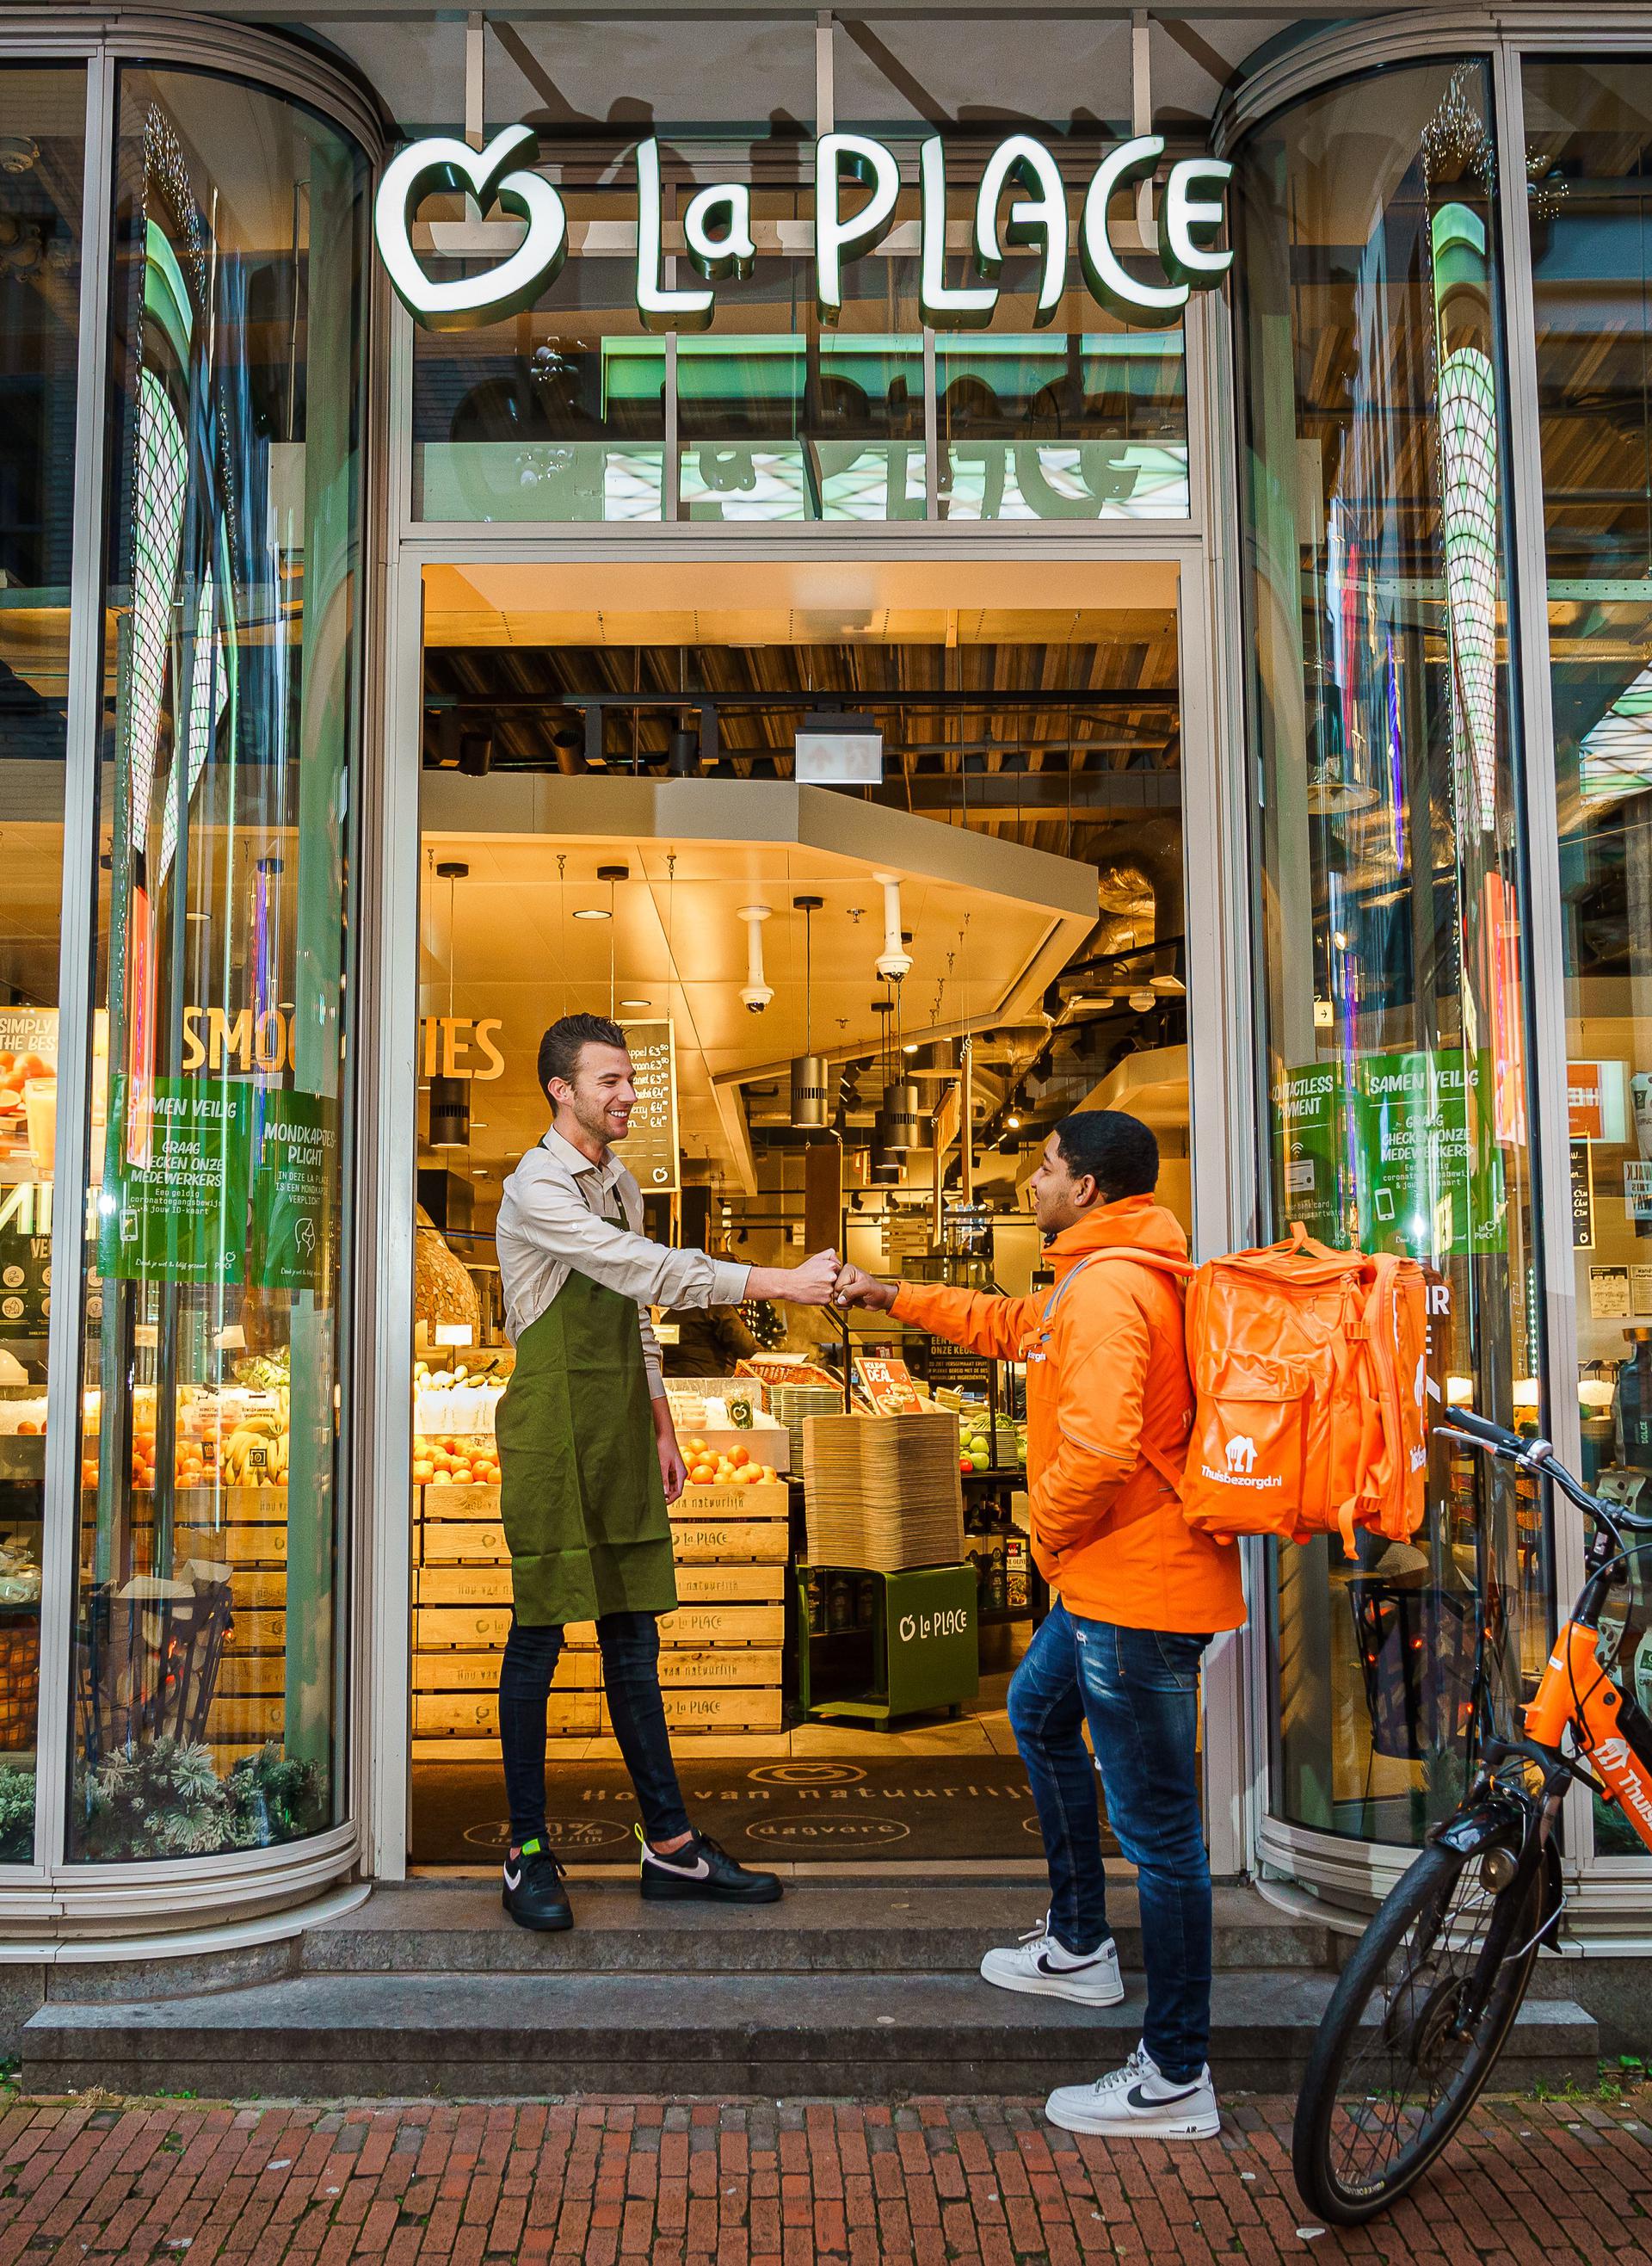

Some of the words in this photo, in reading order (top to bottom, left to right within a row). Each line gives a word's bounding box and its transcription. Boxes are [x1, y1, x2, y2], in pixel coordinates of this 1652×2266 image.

[636, 133, 757, 325] La
[814, 132, 1235, 325] PLACE
[0, 1017, 52, 1034] SIMPLY
[0, 1034, 26, 1051] THE
[28, 1034, 57, 1051] BES
[1369, 1072, 1426, 1095] SAMEN
[162, 1140, 200, 1155] GRAAG
[287, 1145, 324, 1167] PLICHT
[191, 1157, 225, 1171] ONZE
[130, 1169, 224, 1188] MEDEWERKERS
[278, 1170, 287, 1181] IN
[289, 1171, 305, 1182] DEZE
[275, 1182, 286, 1192] IS
[287, 1182, 299, 1193] EEN
[930, 1345, 952, 1355] ONZE
[866, 1368, 896, 1383] DEAL
[1639, 1421, 1649, 1444] DOLCE
[1200, 1464, 1282, 1491] Thuisbezorgd.nl
[683, 1532, 693, 1547] La
[696, 1531, 729, 1547] PLACE
[691, 1615, 723, 1630] PLACE
[920, 1614, 931, 1639] La
[934, 1608, 967, 1637] PLACE
[676, 1701, 687, 1715] La
[689, 1700, 721, 1715] PLACE
[581, 1789, 637, 1801] Ho
[693, 1789, 771, 1801] van
[1618, 1768, 1652, 1831] Thuis
[496, 1822, 604, 1836] 10%
[1186, 2125, 1198, 2133] AIR
